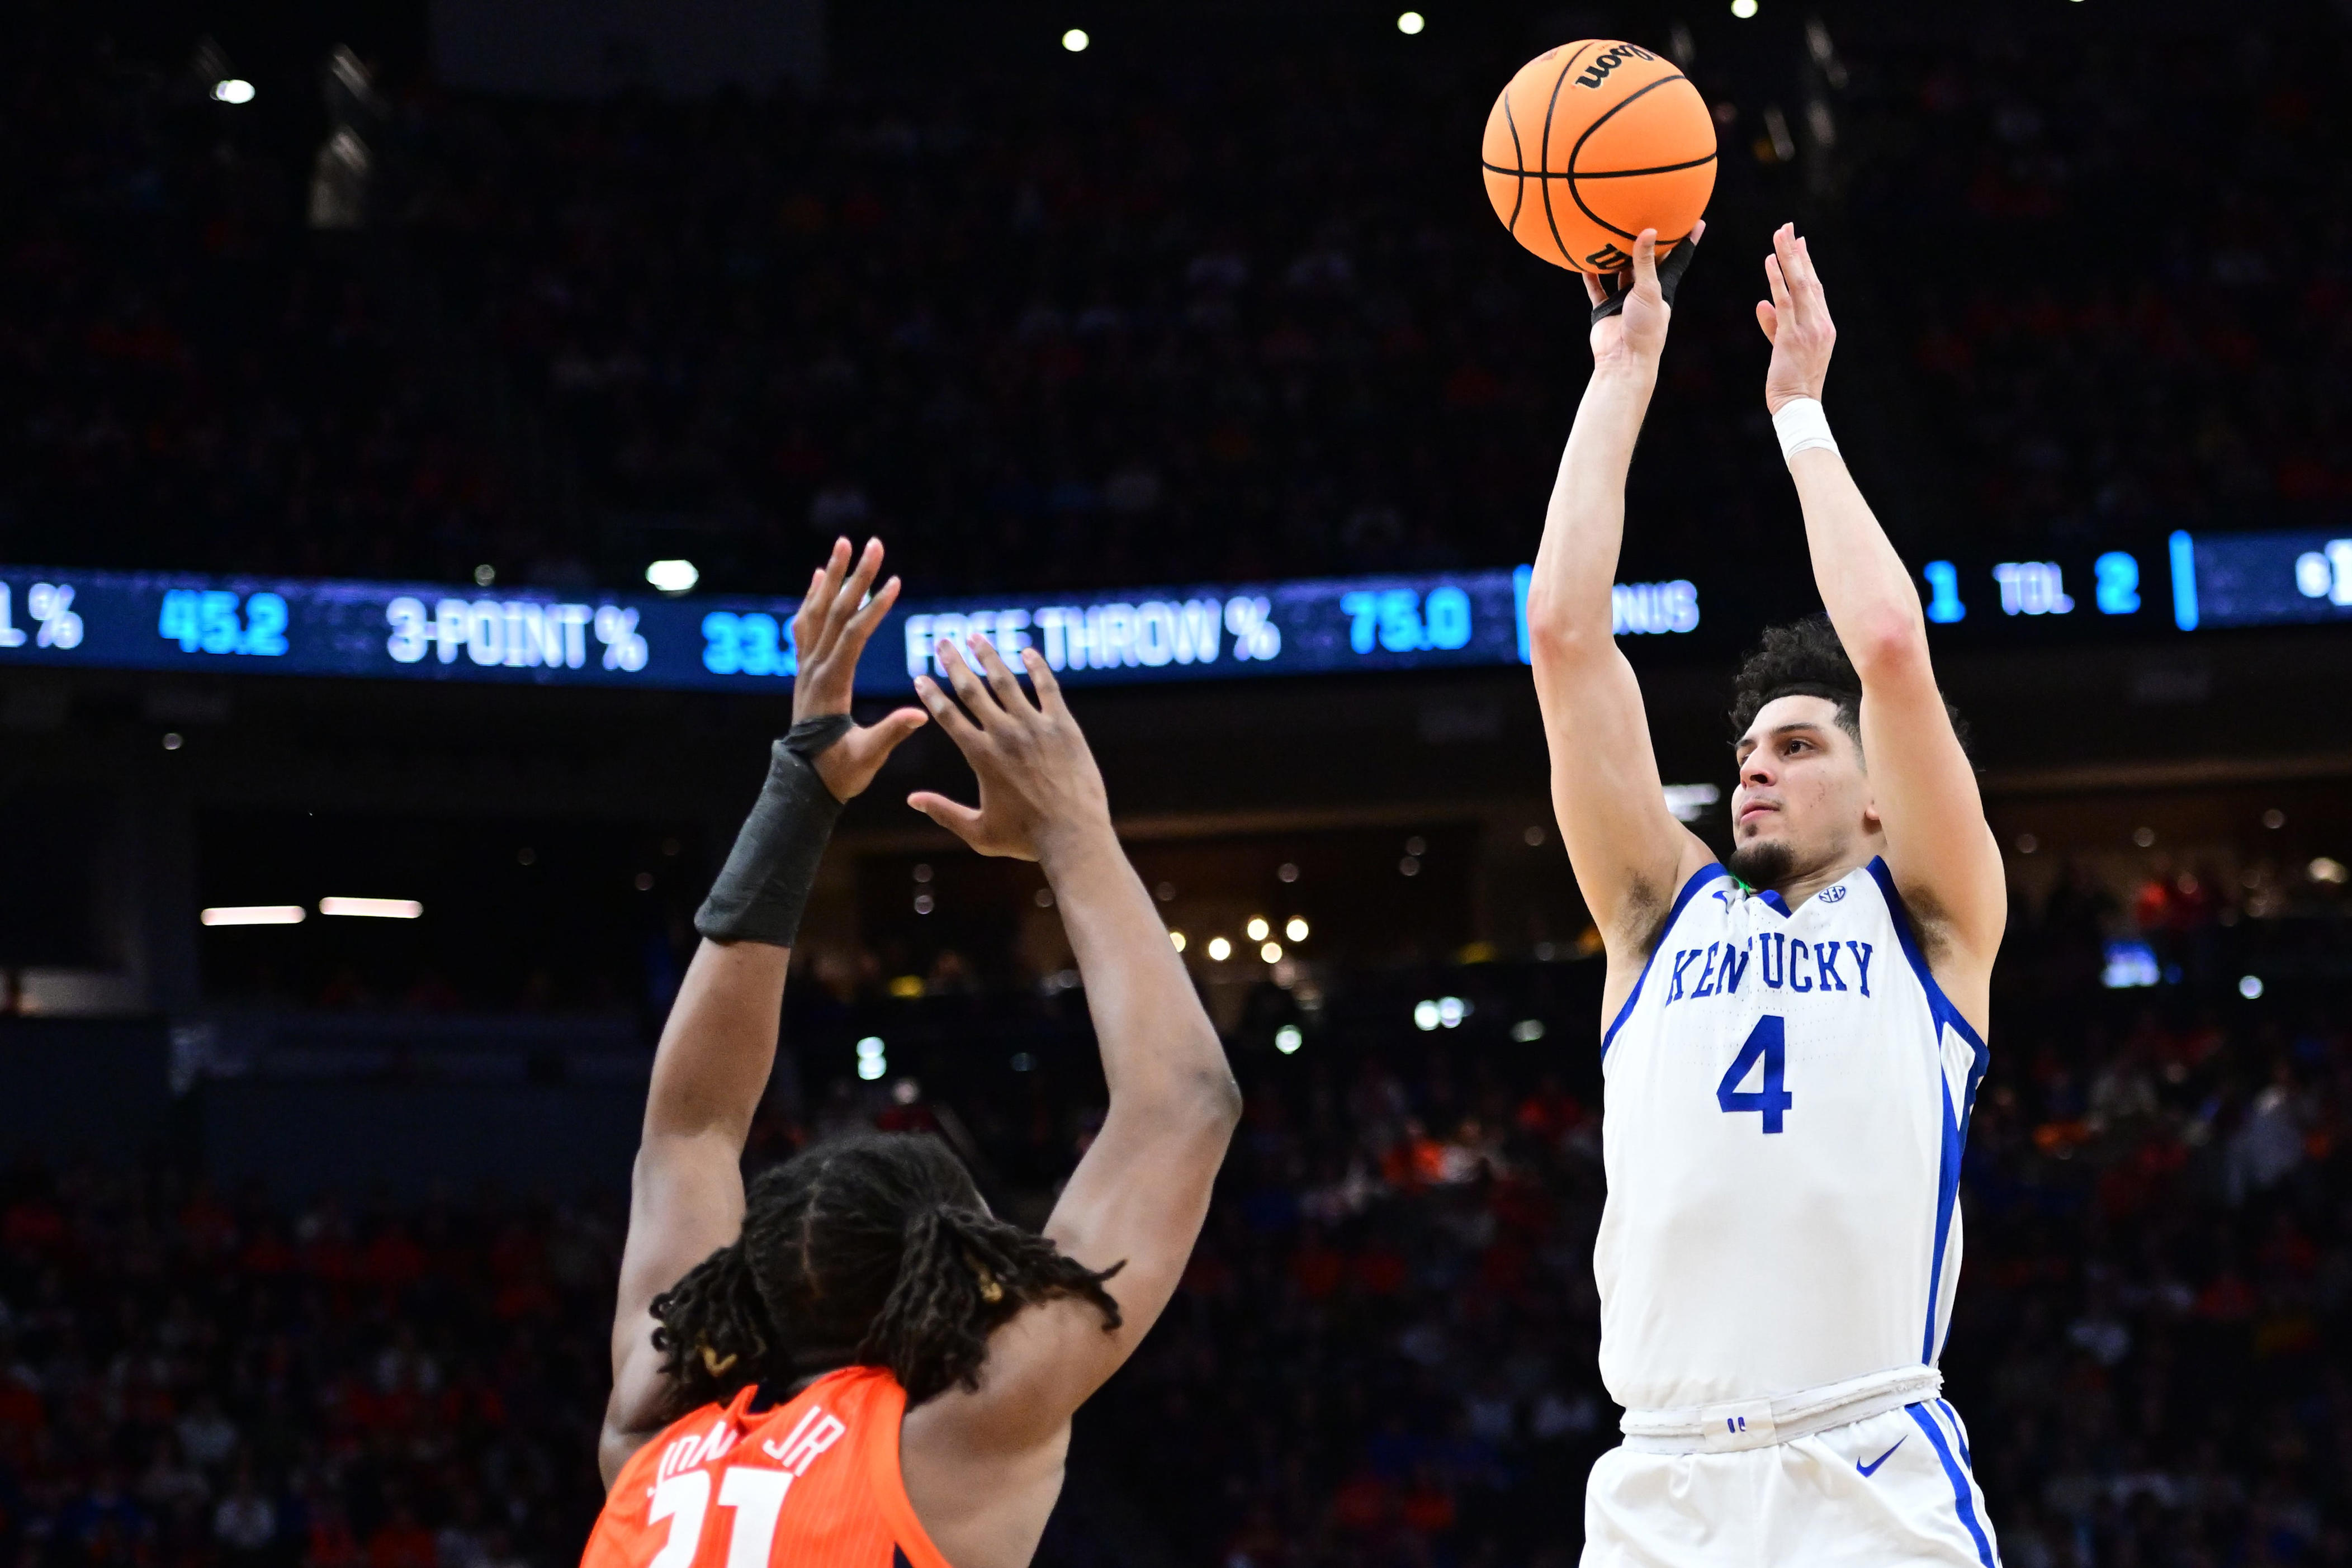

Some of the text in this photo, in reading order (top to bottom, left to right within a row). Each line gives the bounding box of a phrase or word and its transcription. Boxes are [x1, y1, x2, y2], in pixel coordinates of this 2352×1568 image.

[1575, 43, 1659, 89] lson
[29, 582, 84, 649] %
[158, 589, 288, 656] 45.2
[1612, 579, 1700, 635] NUS
[1923, 560, 1966, 623] 1
[2094, 551, 2141, 614] 2
[386, 596, 593, 669] 3-POINT
[594, 605, 649, 672] %
[1034, 598, 1222, 671] THROW
[1225, 596, 1281, 661] %
[1341, 586, 1471, 654] 75.0
[1819, 885, 1846, 903] SEC
[1665, 932, 1873, 1006] KENUCKY
[1716, 1015, 1792, 1134] 4
[762, 1405, 845, 1477] JR
